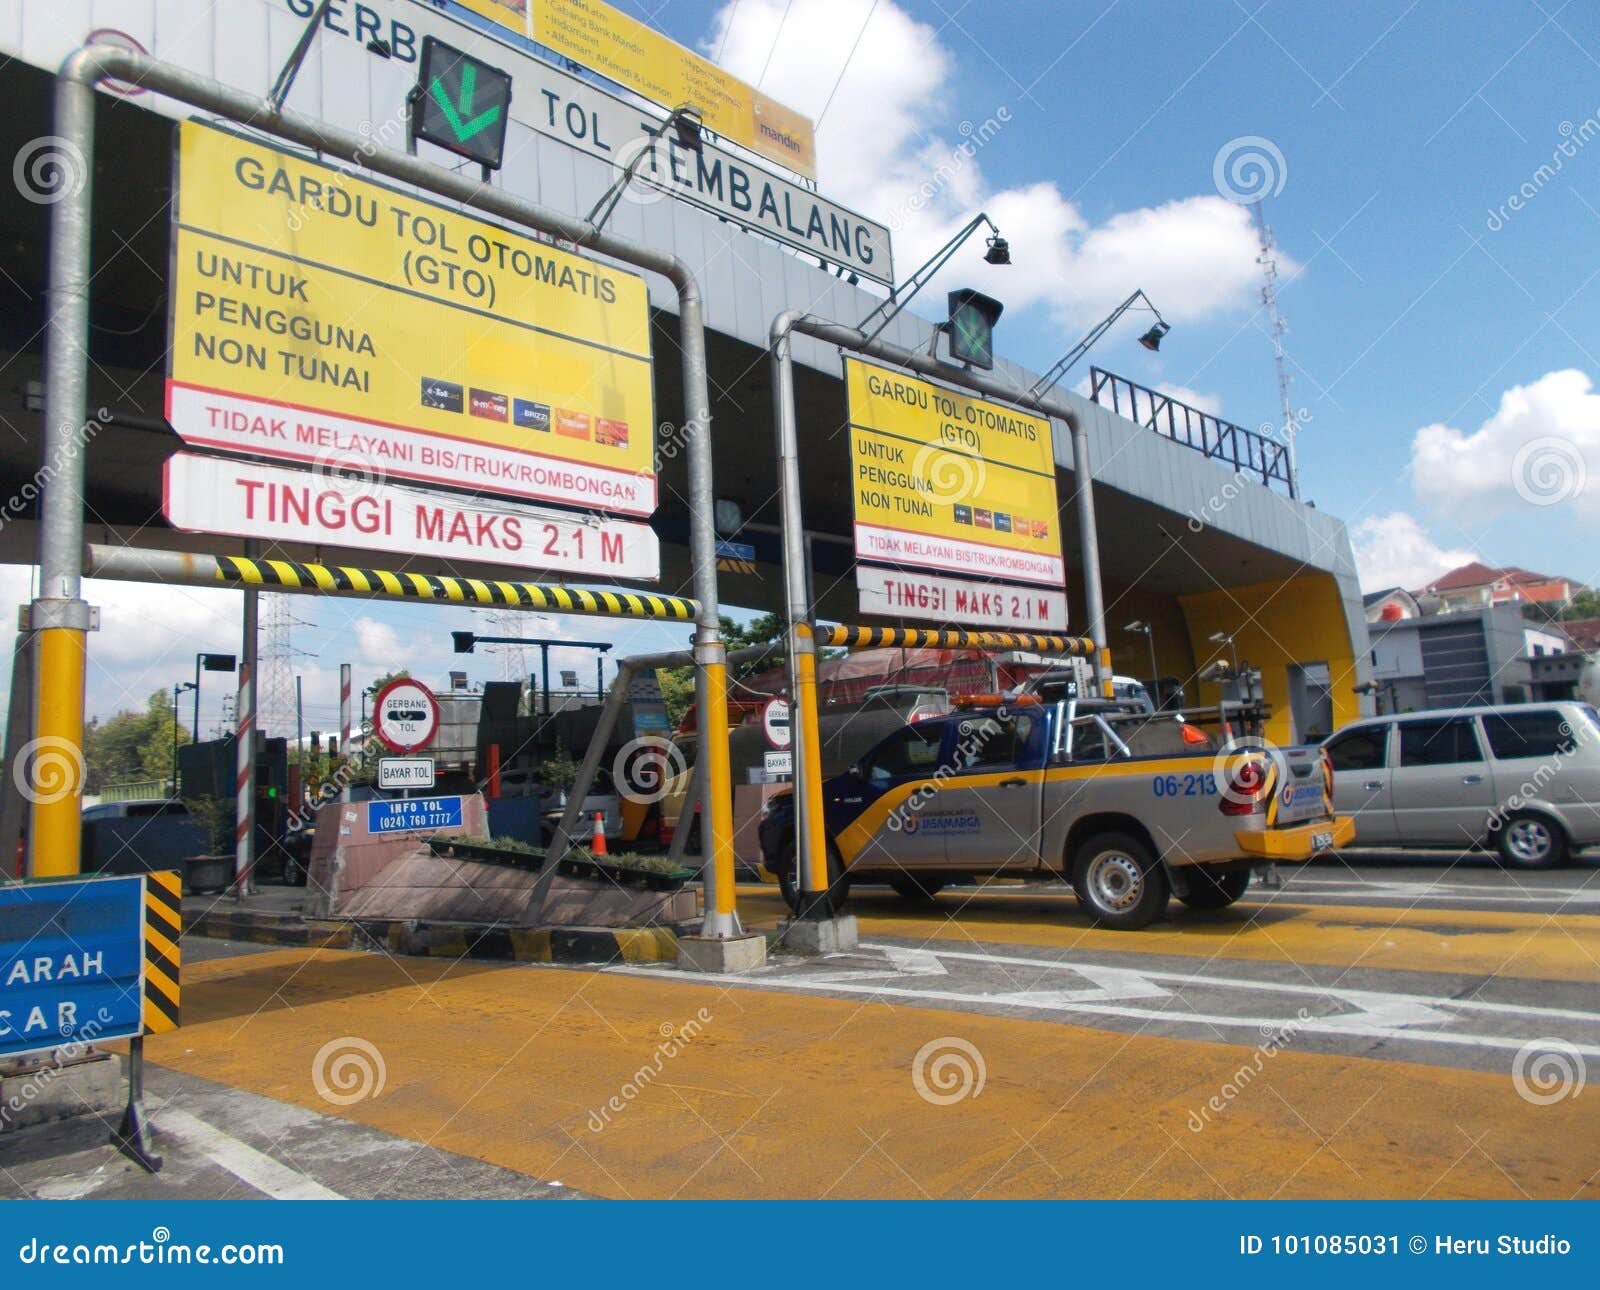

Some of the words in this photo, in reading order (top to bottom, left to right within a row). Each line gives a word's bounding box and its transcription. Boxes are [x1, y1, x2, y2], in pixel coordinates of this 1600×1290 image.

[551, 16, 600, 47] Indomaret
[589, 19, 611, 38] Bank
[642, 78, 672, 99] Lawson
[287, 0, 417, 63] GERB
[541, 88, 611, 151] TOL
[641, 122, 873, 265] TEMBALANG
[760, 124, 800, 153] mandiri
[235, 157, 378, 228] GARDU
[390, 206, 458, 254] TOL
[468, 234, 618, 304] OTOMATIS
[197, 251, 309, 302] UNTUK
[403, 251, 496, 307] (GTO)
[195, 291, 376, 358] PENGGUNA
[194, 332, 266, 371] NON
[278, 350, 369, 393] TUNAI
[869, 375, 928, 410] GARDU
[932, 395, 962, 421] TOL
[966, 406, 1036, 442] OTOMATIS
[858, 439, 904, 463] UNTUK
[940, 422, 981, 452] (GTO)
[205, 406, 287, 441] TIDAK
[296, 423, 414, 463] MELAYANI
[421, 447, 636, 502] BIS/TRUK/ROMBONGAN
[859, 464, 934, 494] PENGGUNA
[860, 491, 890, 510] NON
[894, 496, 933, 517] TUNAI
[236, 479, 392, 537] TINGGI
[415, 505, 522, 552] MAKS
[543, 525, 584, 561] 2.1
[601, 532, 624, 564] M
[868, 535, 901, 551] TIDAK
[904, 542, 953, 560] MELAYANI
[956, 551, 1054, 575] BIS/TRUK/ROMBONGAN
[884, 580, 946, 612] TINGGI
[956, 590, 1003, 617] MAKS
[1011, 596, 1031, 620] 2.1
[1038, 599, 1049, 620] M
[387, 700, 427, 709] GERBANG
[400, 723, 416, 733] TOL
[383, 767, 411, 779] BAYAR
[413, 767, 430, 778] TOL
[768, 759, 786, 768] BAYAR
[1153, 774, 1217, 797] 06-213
[380, 815, 406, 830] (024)
[410, 814, 426, 826] 760
[430, 813, 451, 826] 7777
[390, 802, 418, 813] INFO
[424, 800, 443, 812] TOL
[6, 951, 103, 986] ARAH
